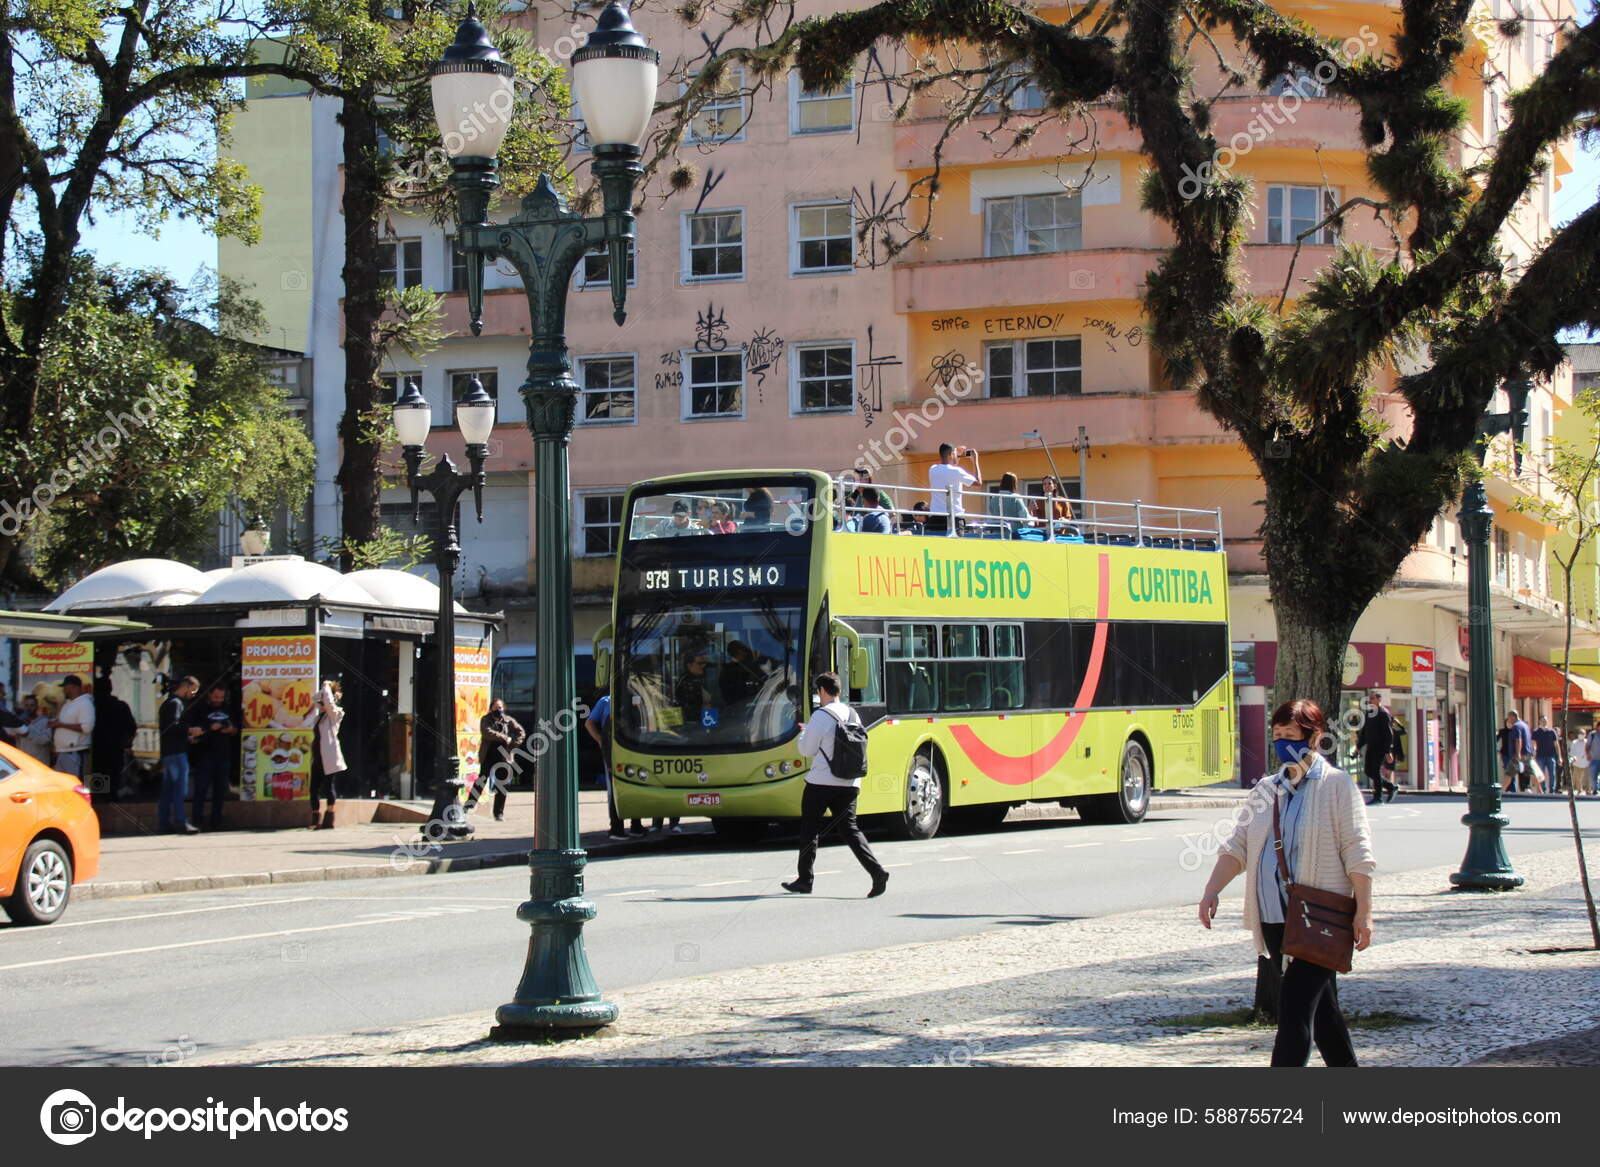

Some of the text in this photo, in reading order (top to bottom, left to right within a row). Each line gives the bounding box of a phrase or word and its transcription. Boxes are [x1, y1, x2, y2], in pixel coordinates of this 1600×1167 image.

[985, 314, 1064, 333] ETERNO!!
[646, 566, 779, 589] 979 TURISMO
[1128, 566, 1213, 605] CURITIBA
[246, 642, 312, 659] PROMOÇÃO
[455, 652, 488, 665] ROMOÇÃO
[244, 666, 313, 677] PÃO DE QUEIJO
[1172, 714, 1194, 728] BT005
[653, 758, 704, 775] BT005
